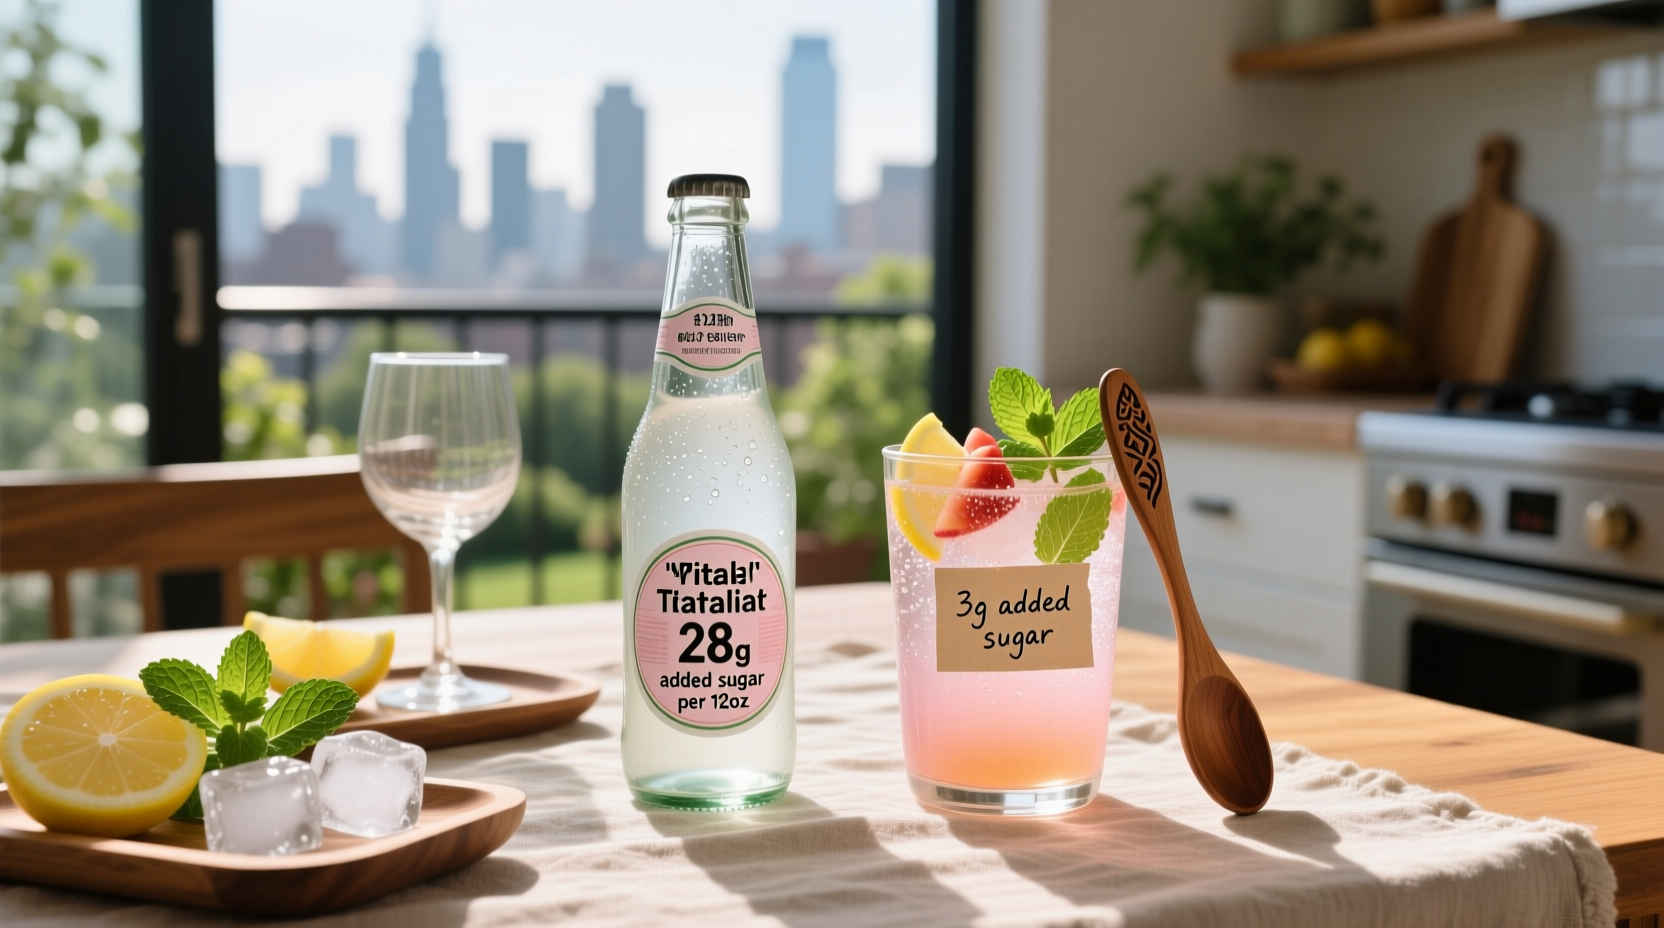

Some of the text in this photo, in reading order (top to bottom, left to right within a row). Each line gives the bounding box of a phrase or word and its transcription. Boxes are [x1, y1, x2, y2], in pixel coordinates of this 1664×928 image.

[956, 584, 1071, 630] 3g added
[678, 621, 751, 667] 28g
[983, 629, 1054, 660] sugar
[659, 671, 765, 691] added sugar
[678, 692, 750, 714] per 12oz
